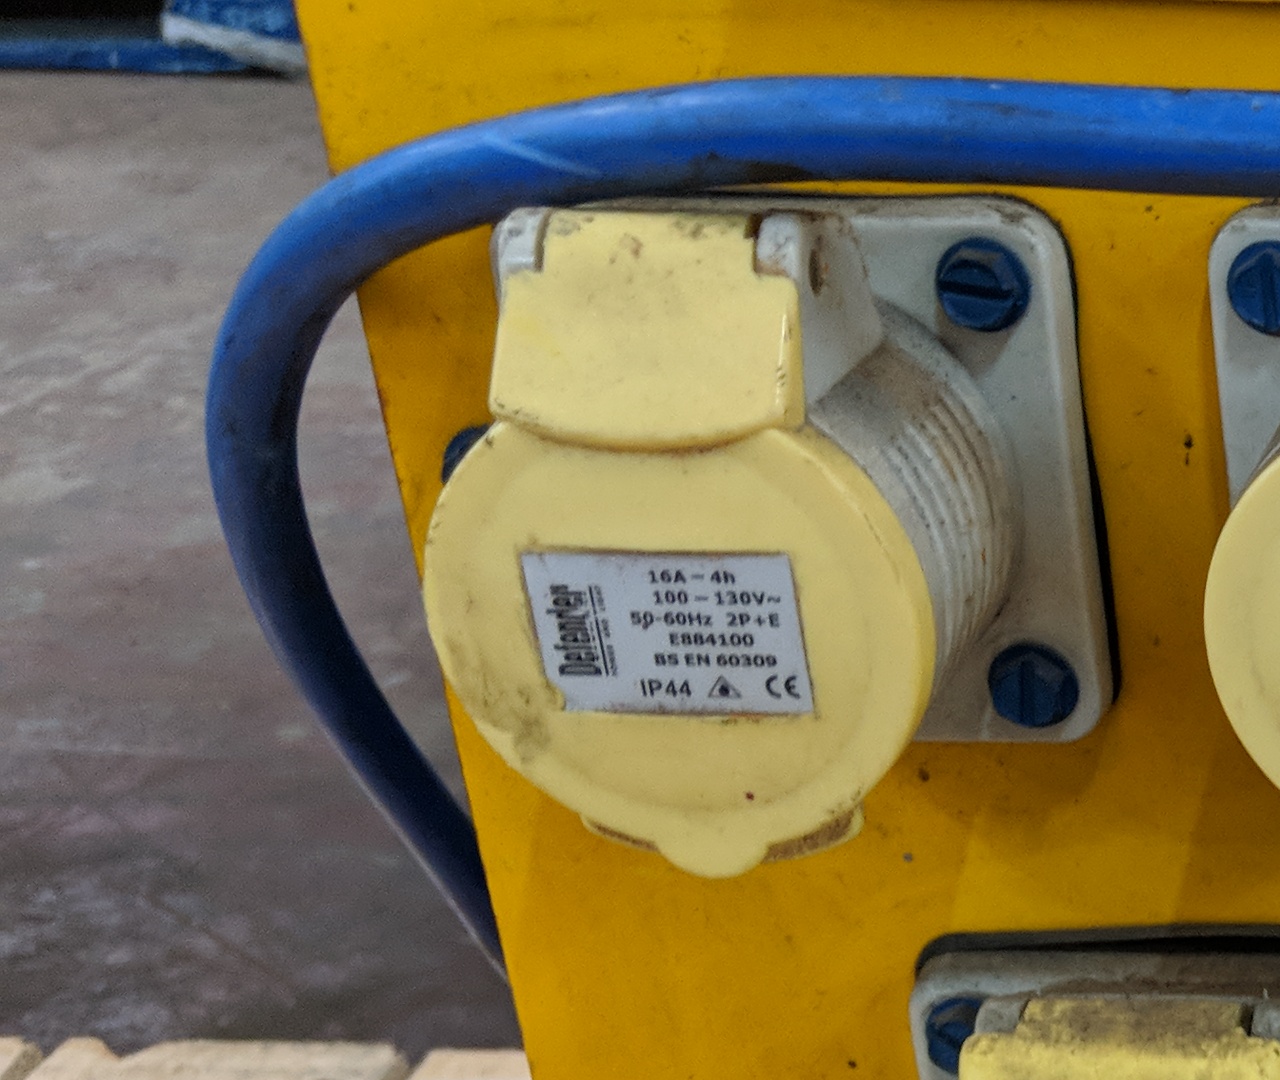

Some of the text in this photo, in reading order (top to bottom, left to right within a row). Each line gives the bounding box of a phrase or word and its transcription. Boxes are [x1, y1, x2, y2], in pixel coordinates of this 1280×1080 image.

[649, 570, 686, 583] 16A
[711, 570, 736, 583] 4h
[653, 591, 688, 605] 100
[630, 612, 712, 627] 50-60Hz
[670, 633, 754, 646] E884100
[655, 654, 777, 667] BS EN 60309
[640, 678, 691, 697] IP44
